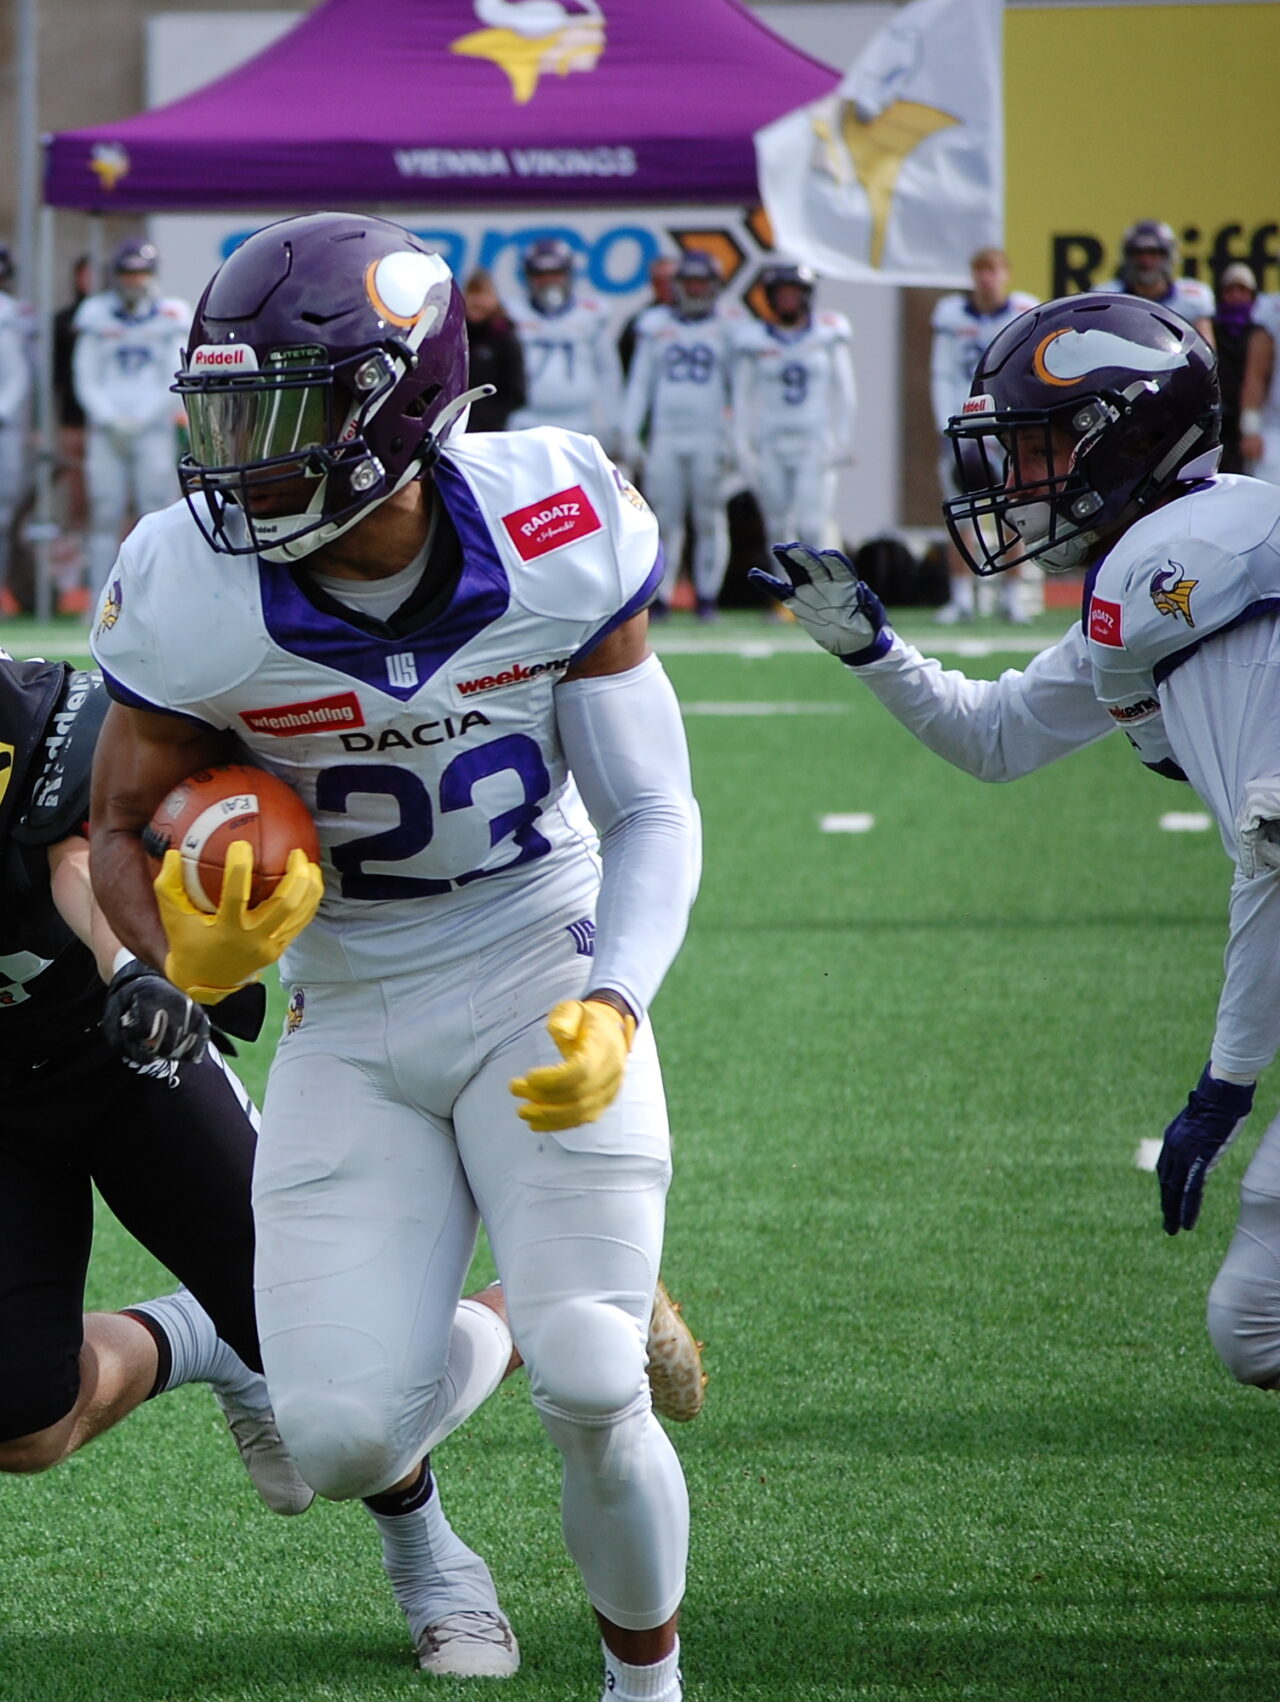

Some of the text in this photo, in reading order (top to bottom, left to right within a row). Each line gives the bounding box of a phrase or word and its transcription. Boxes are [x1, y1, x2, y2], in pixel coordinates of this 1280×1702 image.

[393, 146, 638, 177] VIENNA VIKINGS
[1051, 222, 1280, 298] Riff
[195, 350, 244, 366] Riddell
[521, 502, 581, 537] RADATZ
[249, 705, 355, 729] wienholding
[338, 710, 492, 752] DACIA
[315, 733, 554, 901] 23
